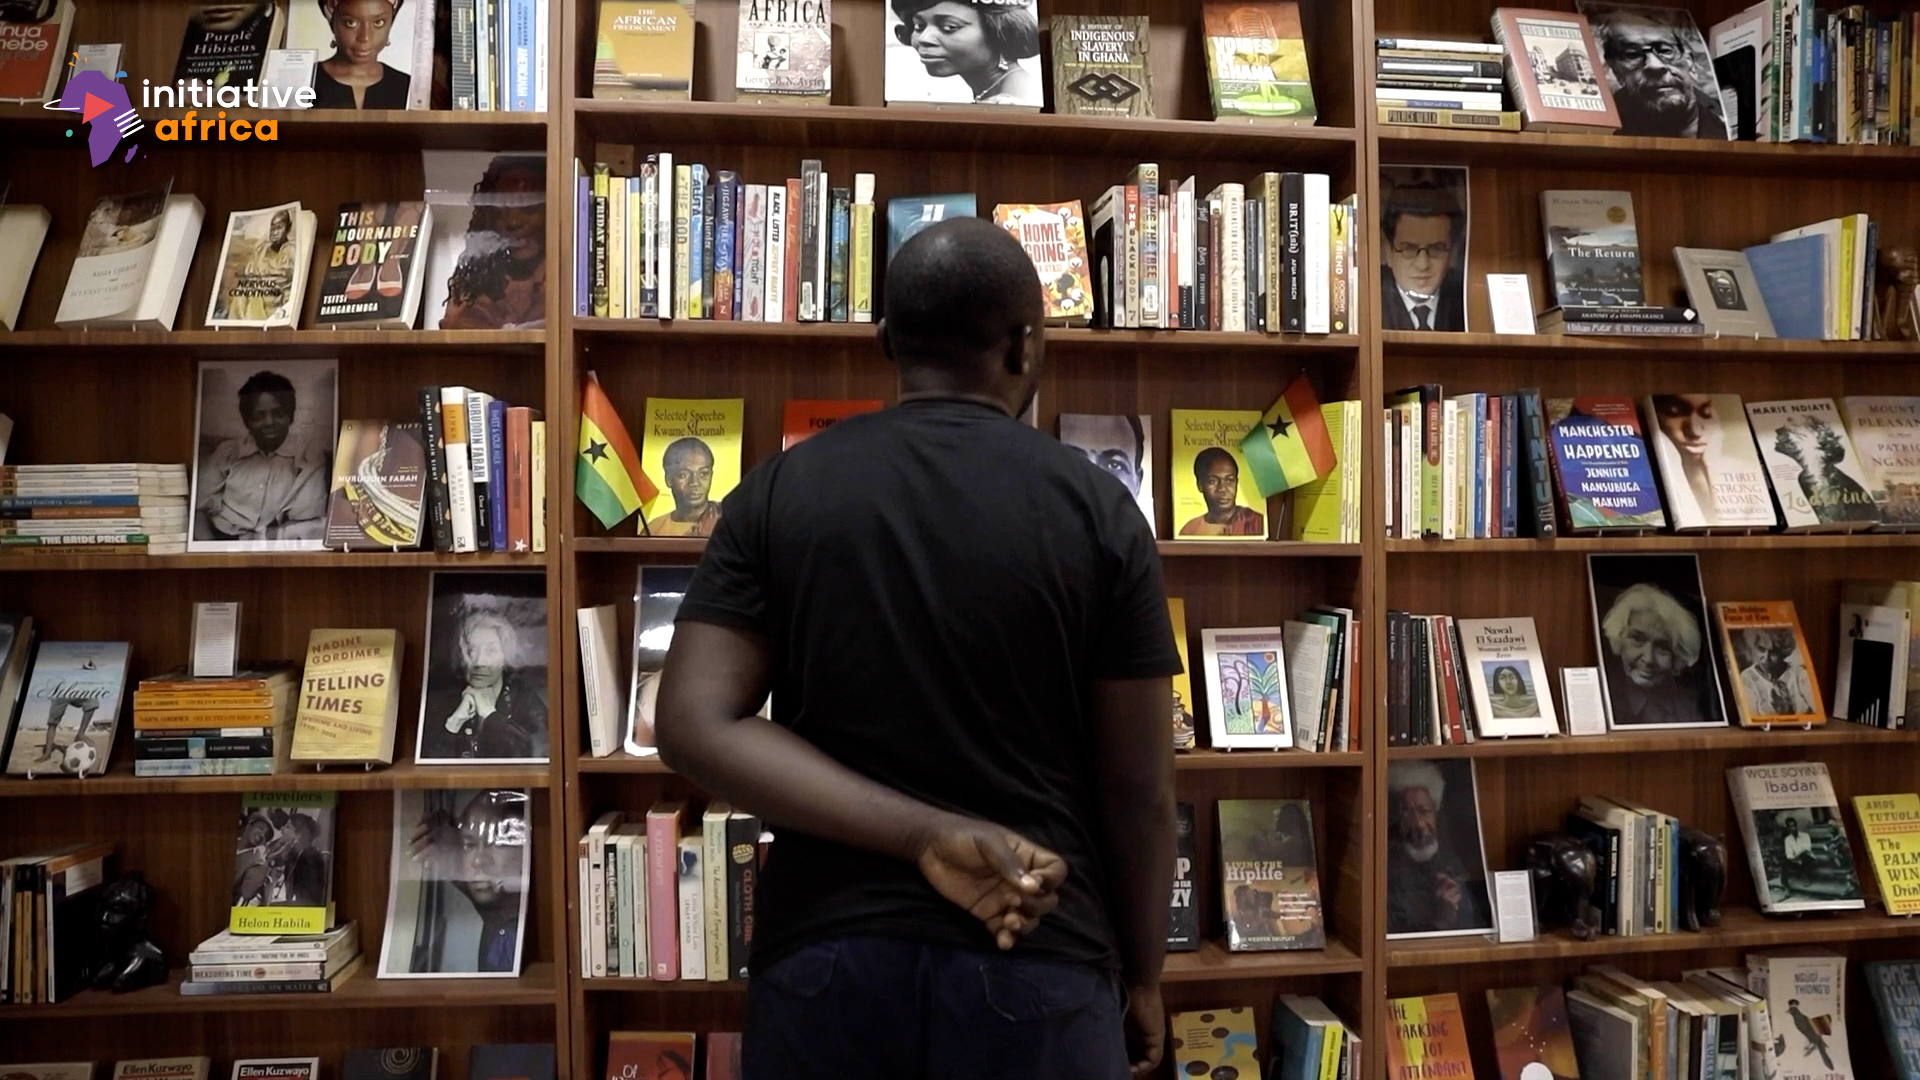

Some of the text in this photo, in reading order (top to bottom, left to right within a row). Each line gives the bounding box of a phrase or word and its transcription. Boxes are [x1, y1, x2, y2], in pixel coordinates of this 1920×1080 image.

[748, 0, 826, 23] AFRICA
[614, 16, 677, 25] AFRICAN
[204, 31, 252, 43] Purple
[1071, 30, 1135, 42] INDIGENOUS
[193, 43, 257, 55] Hibiscus
[1082, 42, 1124, 52] SLAVERY
[1213, 37, 1273, 54] VOICES
[1079, 52, 1129, 63] IN GHANA
[1216, 52, 1236, 66] OF
[516, 48, 528, 97] AMERICANAH
[1218, 65, 1276, 81] GHANA
[692, 179, 702, 217] ALUTA
[721, 187, 729, 220] JIGSAW
[771, 192, 780, 217] BLACK,
[340, 211, 374, 227] THIS
[1145, 170, 1157, 278] SHAKING THE TREE
[335, 225, 419, 243] MOURNABLE
[704, 215, 714, 250] Murder
[771, 218, 780, 243] LISTED
[1023, 223, 1062, 242] HOME
[1288, 203, 1299, 254] BRIT(ish)
[595, 197, 605, 287] FRIDAY BLACK
[1197, 206, 1209, 267] Half Blues
[330, 241, 393, 268] BODY
[1024, 242, 1066, 263] GOING
[1335, 240, 1344, 275] FRIEND
[1568, 248, 1635, 258] The Return
[750, 259, 760, 285] TIGHT
[237, 280, 277, 288] NERVOUS
[323, 295, 347, 305] TSITSI
[320, 303, 378, 316] DANGAREMBGA
[654, 409, 725, 423] Selected Speeches
[1752, 404, 1832, 415] MARIE NDIAYE
[1869, 404, 1915, 414] MOUNT
[449, 409, 457, 439] LINKS
[491, 409, 500, 428] SWEET
[1185, 419, 1216, 431] Selected
[427, 423, 433, 431] IN
[654, 424, 725, 436] Kwame Nkrumah
[1559, 424, 1634, 438] MANCHESTER
[469, 396, 485, 479] NURUDDIN FARAH
[492, 433, 500, 450] SOUR
[1184, 434, 1214, 446] Kwame
[1525, 394, 1549, 504] KINTU
[1563, 444, 1640, 460] HAPPENED
[1585, 467, 1629, 478] JENNIFER
[1721, 472, 1758, 482] THREE
[1581, 482, 1641, 492] NANSUBUGA
[1713, 484, 1762, 494] STRONG
[1592, 497, 1638, 508] MAKUMBI
[40, 536, 62, 544] THE
[62, 536, 96, 544] BRIDE
[96, 535, 128, 544] PRICE
[1484, 626, 1512, 634] Nawal
[312, 636, 363, 654] NADINE
[1476, 634, 1525, 644] El Saadawi
[312, 648, 381, 665] GORDIMER
[37, 677, 111, 700] Atlantic
[306, 673, 385, 692] TELLING
[306, 696, 363, 714] TIMES
[333, 722, 348, 730] AND
[1746, 768, 1778, 779] WOLE
[1766, 780, 1818, 793] Ibadan
[1866, 800, 1895, 810] AMOS
[1868, 811, 1920, 822] TUTUOLA
[1876, 838, 1900, 850] The
[1226, 866, 1283, 884] Hiplife
[742, 869, 753, 945] CLOTH GIRL
[238, 917, 311, 928] Helon Habila
[194, 968, 252, 978] MEASURING TIME
[1396, 1021, 1449, 1040] PARKING
[123, 1063, 193, 1074] Ellen Kuzwayo
[240, 1066, 310, 1078] Ellen Kuzwayo
[1400, 1061, 1467, 1080] ATTENDANT
